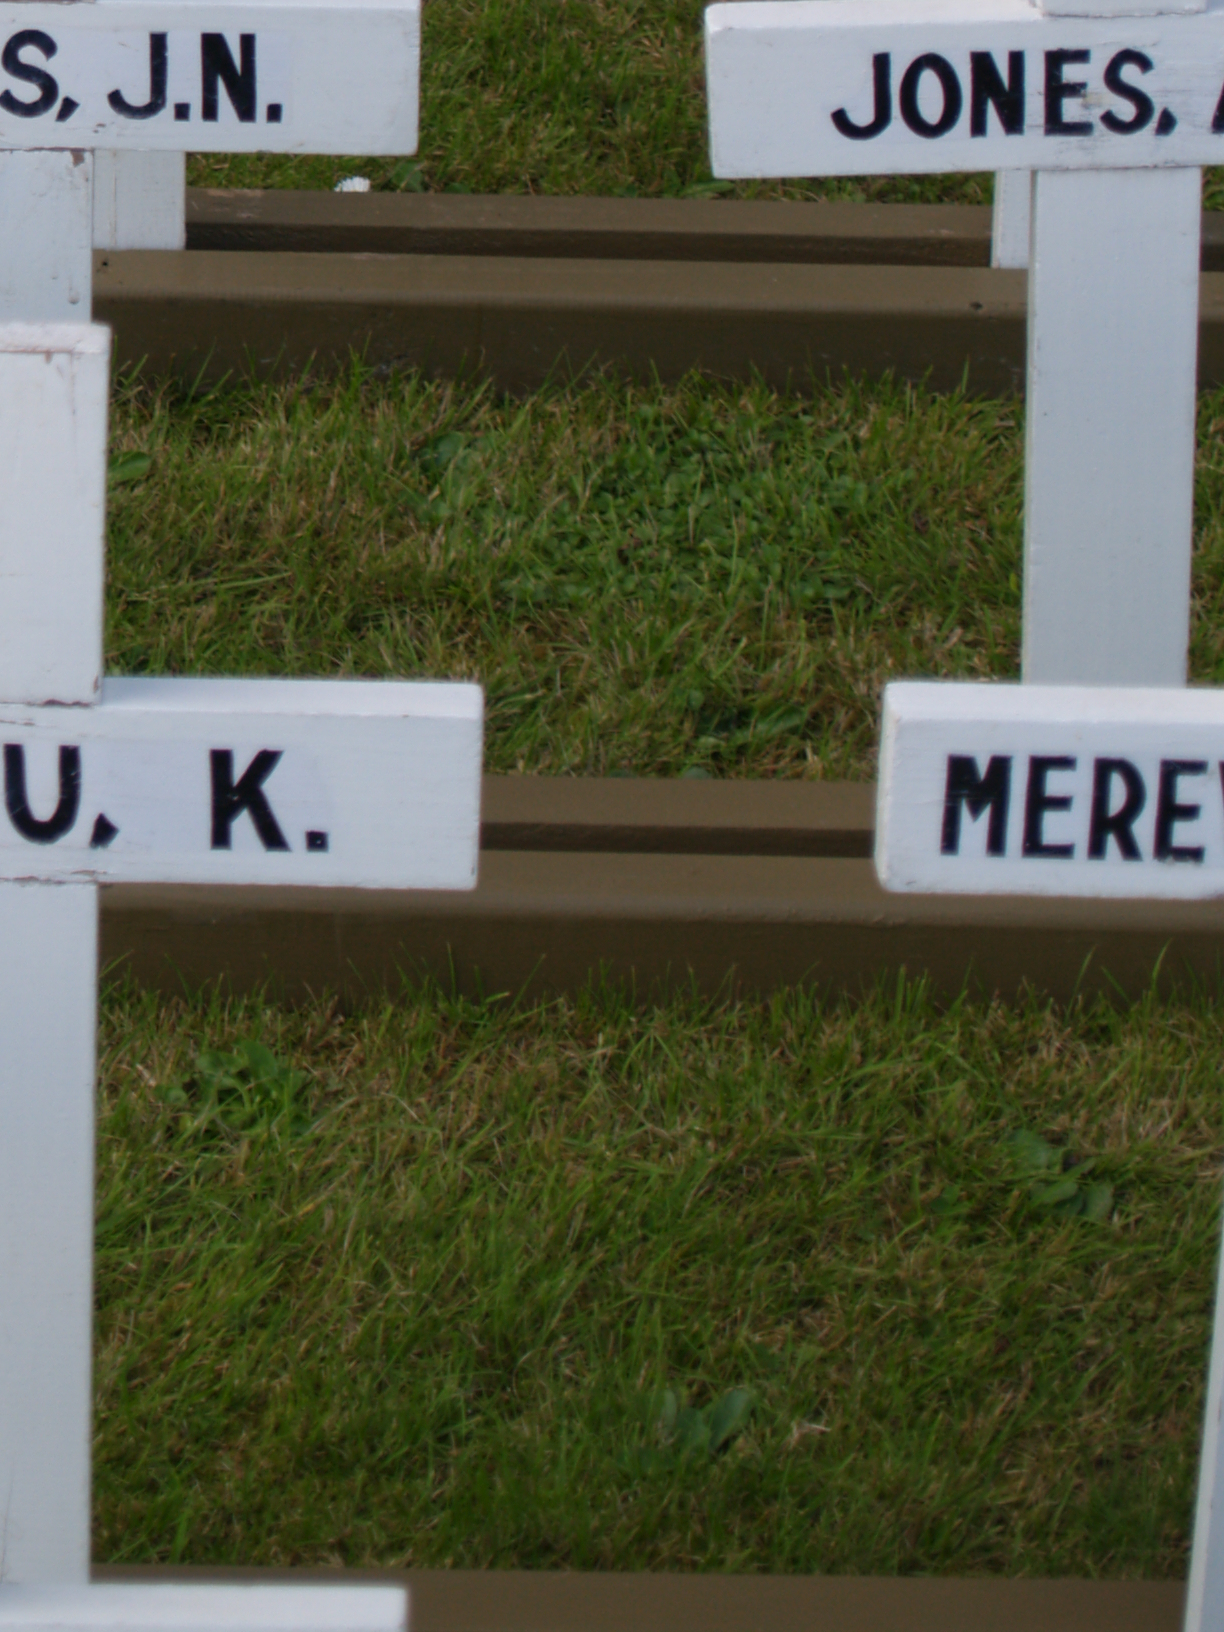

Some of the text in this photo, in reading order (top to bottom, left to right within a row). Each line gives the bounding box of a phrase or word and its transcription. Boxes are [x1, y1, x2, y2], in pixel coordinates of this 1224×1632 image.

[106, 31, 283, 124] J.N.
[829, 47, 1178, 141] JONES,
[208, 748, 329, 853] K.
[940, 754, 1224, 864] MERE
